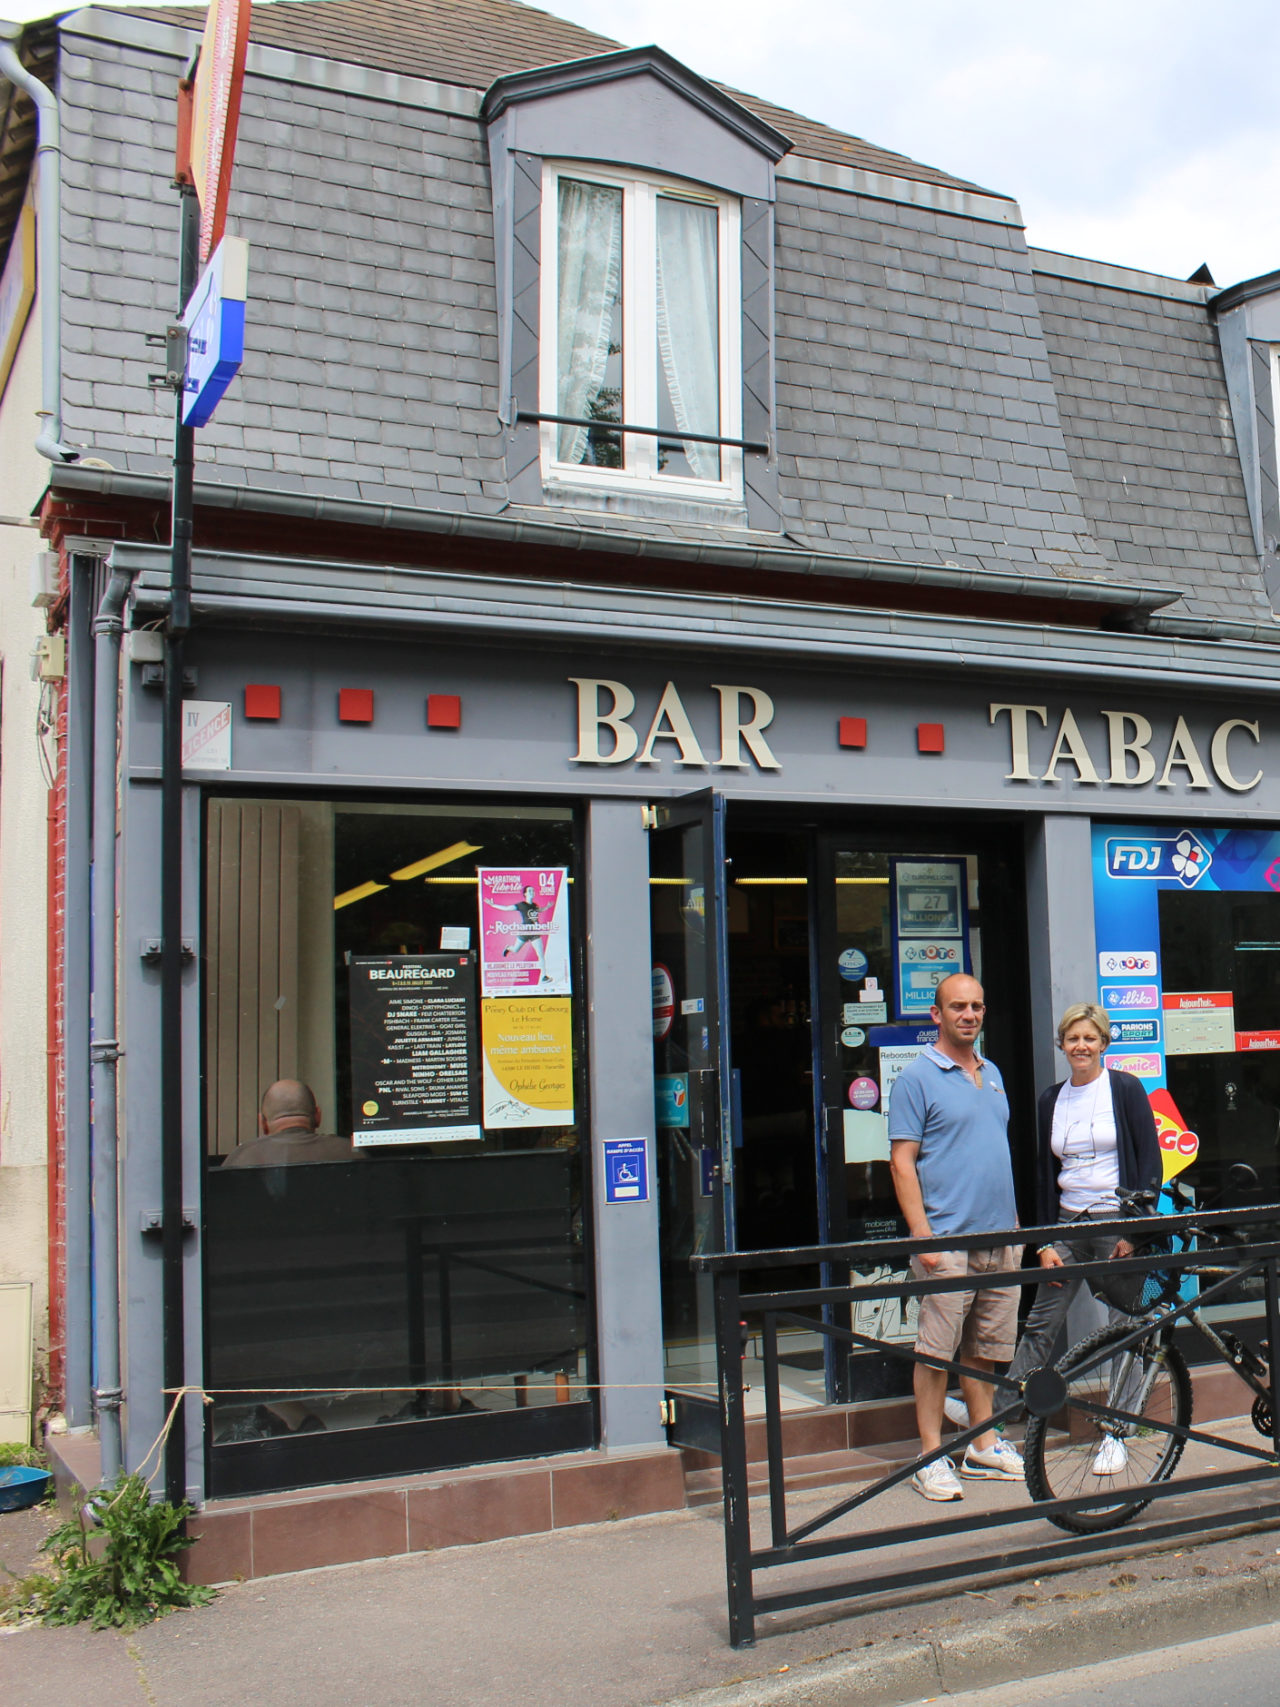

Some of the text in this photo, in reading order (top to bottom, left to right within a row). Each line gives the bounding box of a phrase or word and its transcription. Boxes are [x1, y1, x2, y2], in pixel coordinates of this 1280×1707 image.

[567, 677, 783, 769] BAR
[989, 702, 1263, 791] TABAC
[1112, 846, 1162, 870] FDJ
[539, 872, 555, 886] 04
[924, 896, 941, 909] 27
[495, 920, 559, 934] Rochambelle
[919, 945, 956, 960] LOTO
[1119, 956, 1150, 969] LOTO
[369, 968, 455, 980] BEAUREGARD
[931, 972, 939, 985] 5
[1119, 990, 1152, 1004] illiko
[498, 1034, 536, 1042] Nouveau
[491, 1045, 518, 1054] même
[521, 1044, 561, 1054] ambiance
